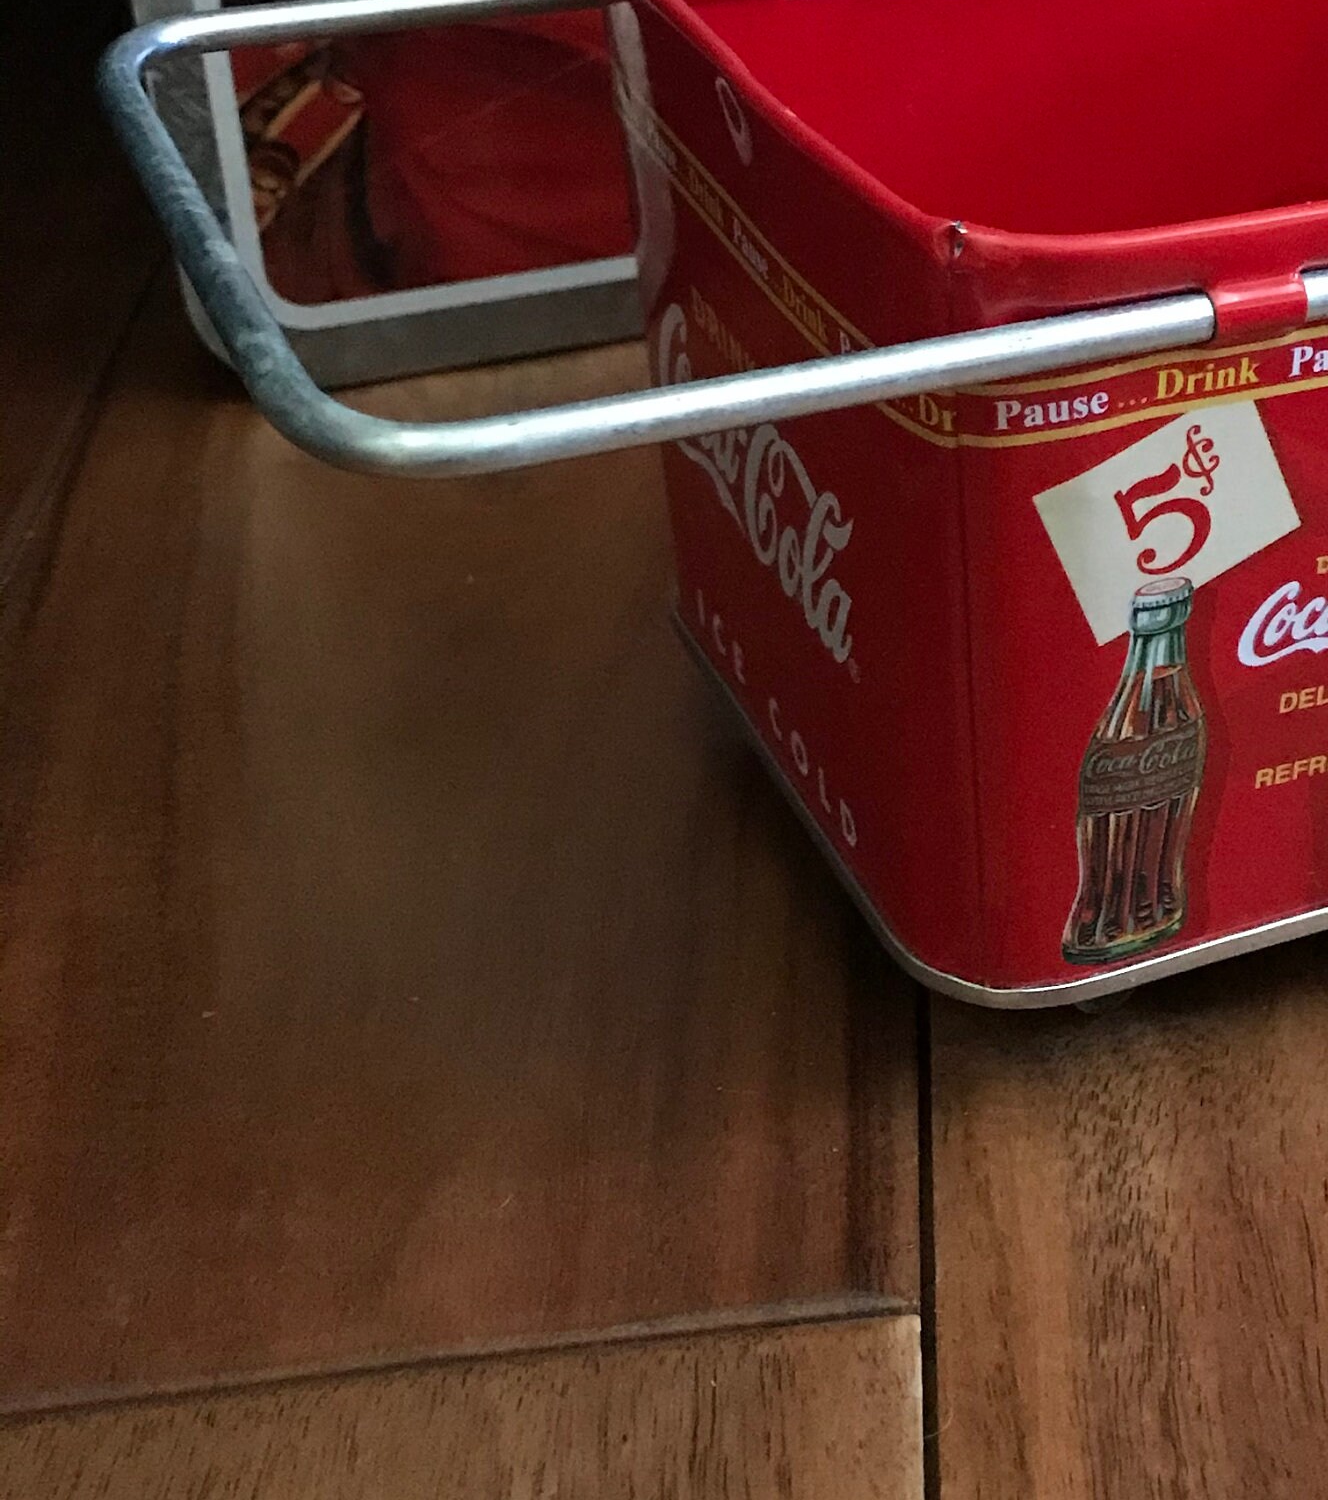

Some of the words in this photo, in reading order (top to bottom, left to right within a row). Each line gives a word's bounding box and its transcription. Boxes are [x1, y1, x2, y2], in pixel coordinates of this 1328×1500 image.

[690, 285, 755, 372] DRIN
[1155, 356, 1261, 401] Drink
[658, 302, 854, 664] Ca-Cola
